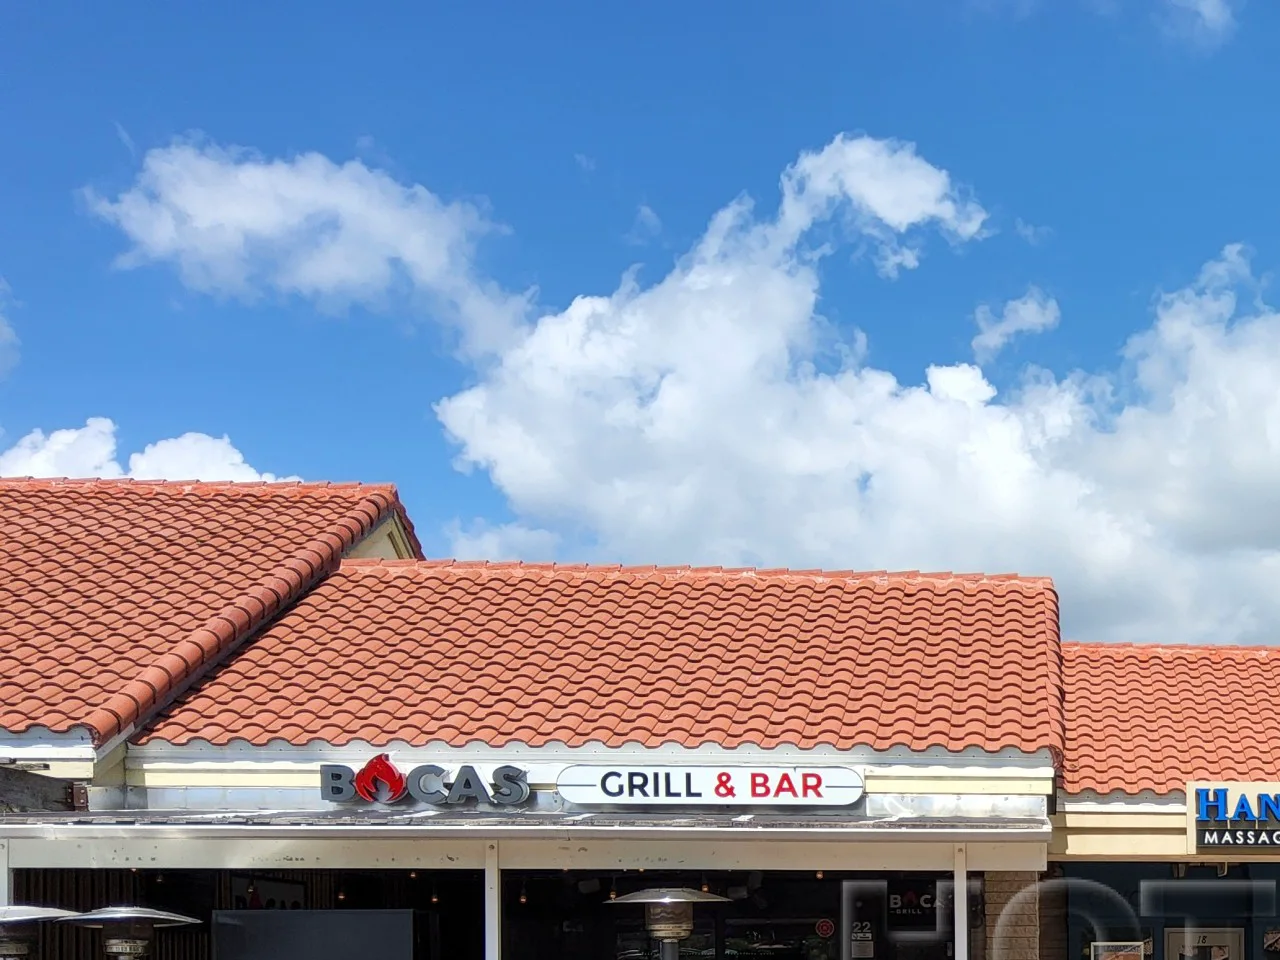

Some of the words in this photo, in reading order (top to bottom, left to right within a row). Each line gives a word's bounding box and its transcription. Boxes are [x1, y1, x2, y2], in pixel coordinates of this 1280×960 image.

[600, 771, 702, 798] GRILL
[714, 771, 737, 798] &
[749, 772, 824, 798] BAR
[851, 921, 872, 933] 22
[1197, 935, 1207, 945] 18
